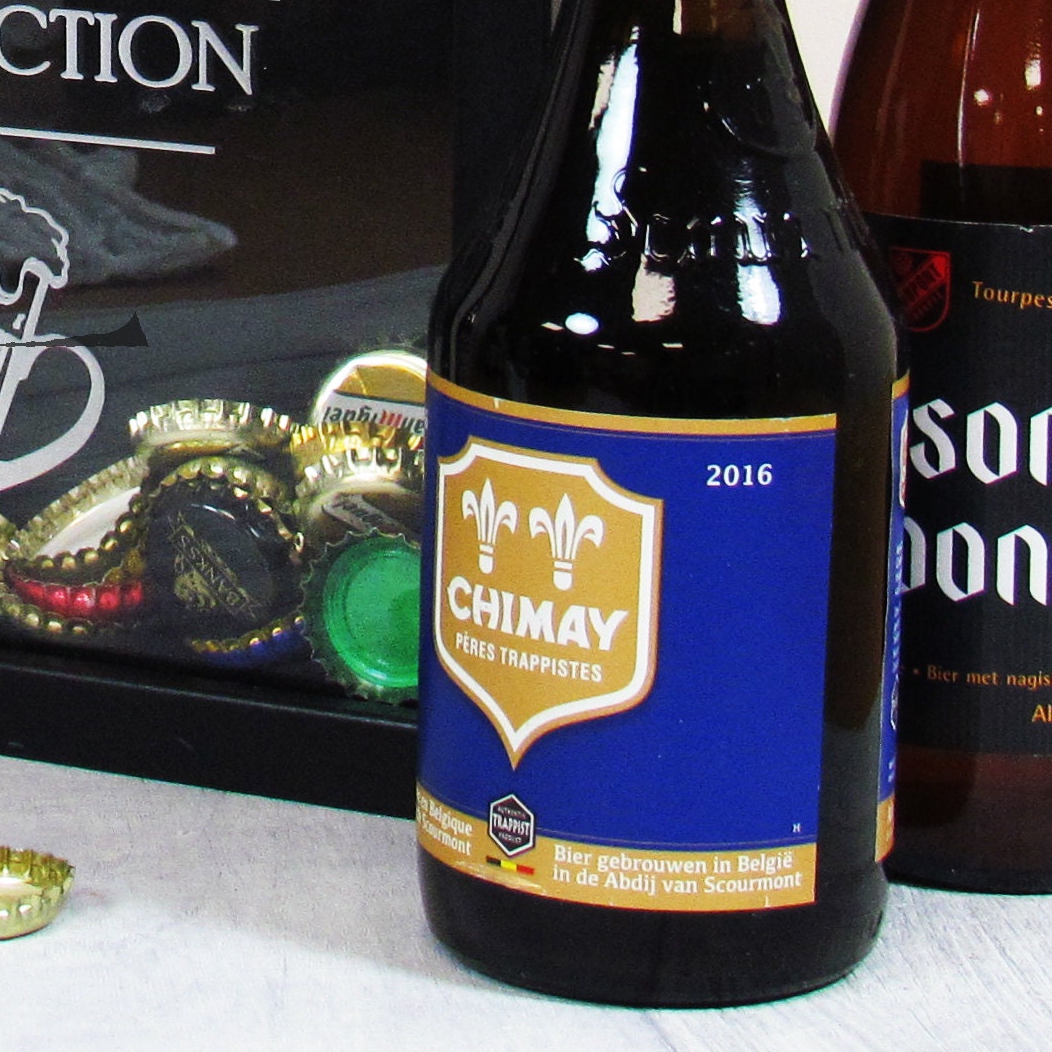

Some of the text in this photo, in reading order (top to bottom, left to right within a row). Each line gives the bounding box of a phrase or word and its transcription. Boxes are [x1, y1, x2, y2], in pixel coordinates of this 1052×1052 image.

[706, 463, 773, 487] 2016
[447, 576, 629, 652] CHIMAY
[499, 647, 603, 683] TRAPPISTES
[927, 663, 959, 682] Bier
[966, 671, 998, 686] met
[492, 812, 530, 836] TRAPPIST
[554, 844, 793, 875] Bier gebrouwen in België
[552, 864, 803, 896] in de Abdij van Scourmont
